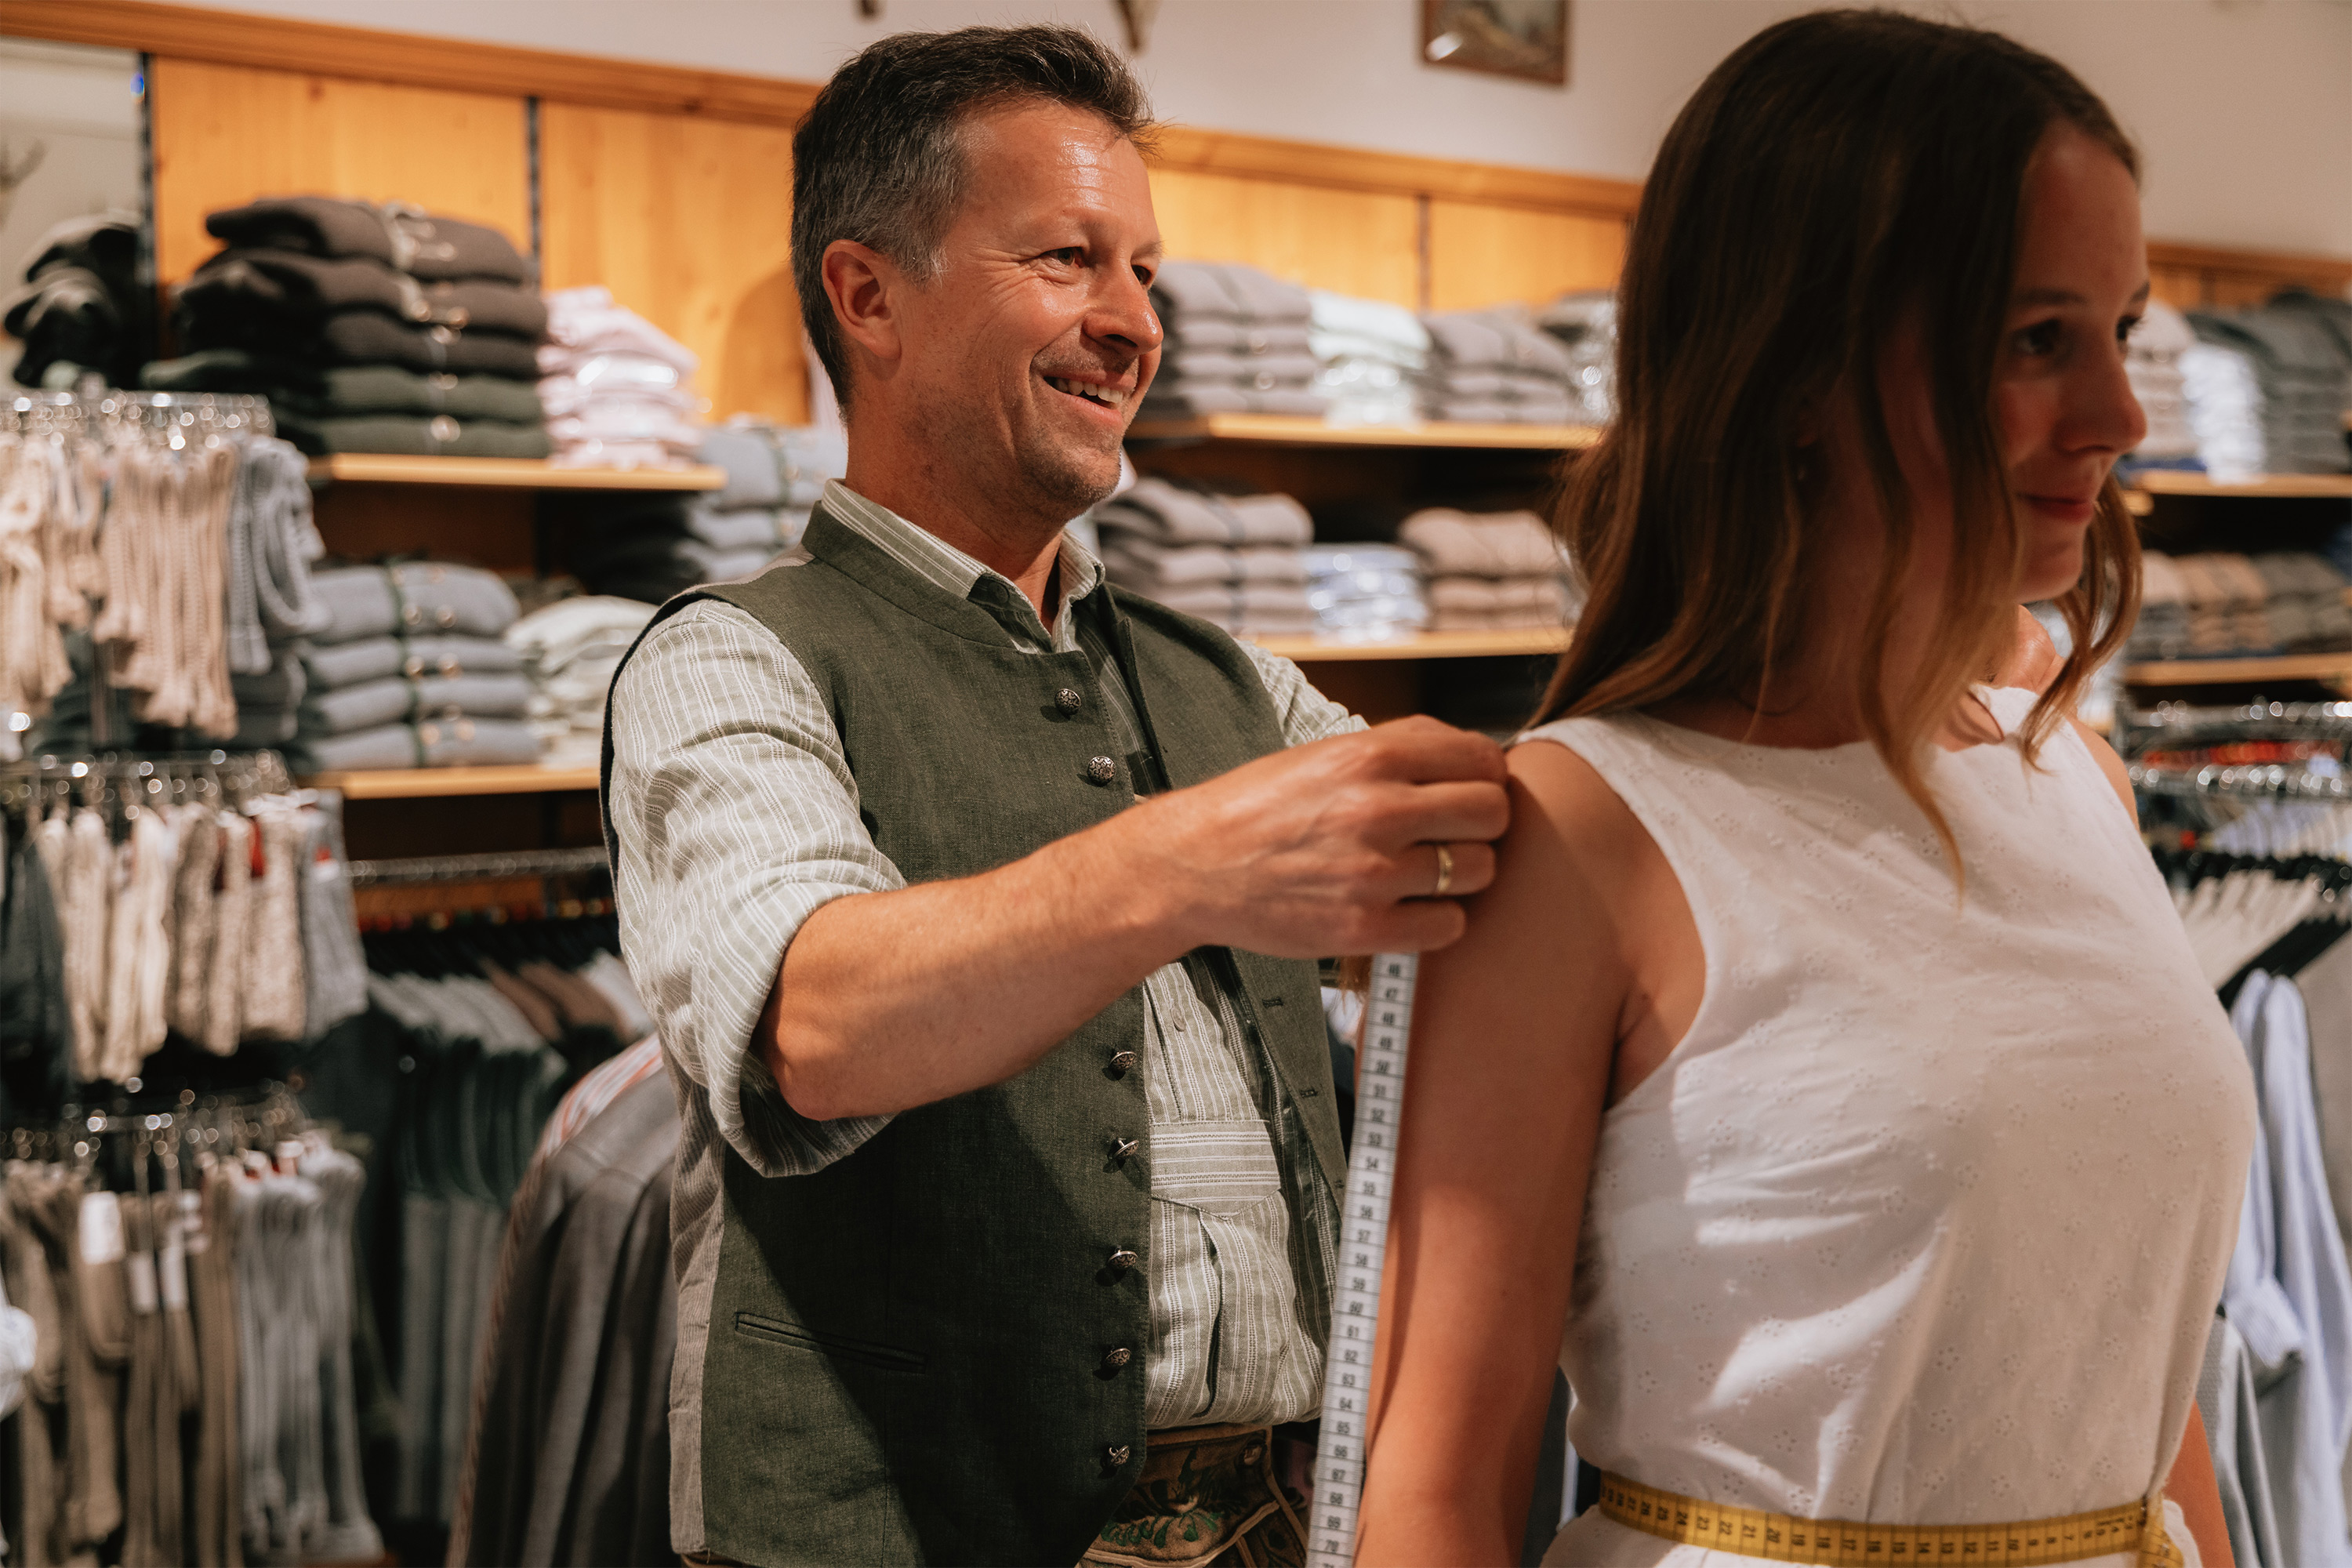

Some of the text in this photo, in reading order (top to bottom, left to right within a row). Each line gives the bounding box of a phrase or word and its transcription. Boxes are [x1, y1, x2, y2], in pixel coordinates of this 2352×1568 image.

[1370, 1109, 1385, 1122] 52
[1368, 1132, 1382, 1145] 53
[1367, 1157, 1378, 1169] 54
[1363, 1181, 1376, 1196] 55
[1360, 1206, 1373, 1219] 56
[1358, 1229, 1371, 1243] 57
[1356, 1254, 1368, 1267] 58
[1352, 1277, 1366, 1290] 59
[1349, 1301, 1363, 1316] 60
[1347, 1326, 1359, 1339] 61
[1345, 1349, 1358, 1363] 62
[1342, 1374, 1356, 1387] 63
[1339, 1398, 1352, 1411] 64
[1337, 1421, 1350, 1436] 65
[1334, 1445, 1348, 1458] 66
[1332, 1468, 1345, 1482] 67
[1330, 1492, 1343, 1505] 68
[1641, 1501, 1651, 1515] 26
[1657, 1506, 1668, 1520] 25
[1327, 1516, 1341, 1530] 69
[1677, 1511, 1687, 1526] 24
[1697, 1516, 1709, 1530] 23
[1719, 1521, 1733, 1535] 22
[1743, 1525, 1755, 1538] 21
[1767, 1529, 1780, 1543] 20
[1791, 1534, 1806, 1546] 19
[1324, 1540, 1339, 1554] 70
[1843, 1539, 1857, 1551] 17
[1893, 1542, 1906, 1554] 15
[1918, 1543, 1930, 1553] 14
[1941, 1542, 1955, 1554] 13
[1964, 1542, 1976, 1553] 12
[1987, 1541, 1999, 1551] 11
[2008, 1539, 2019, 1551] 10
